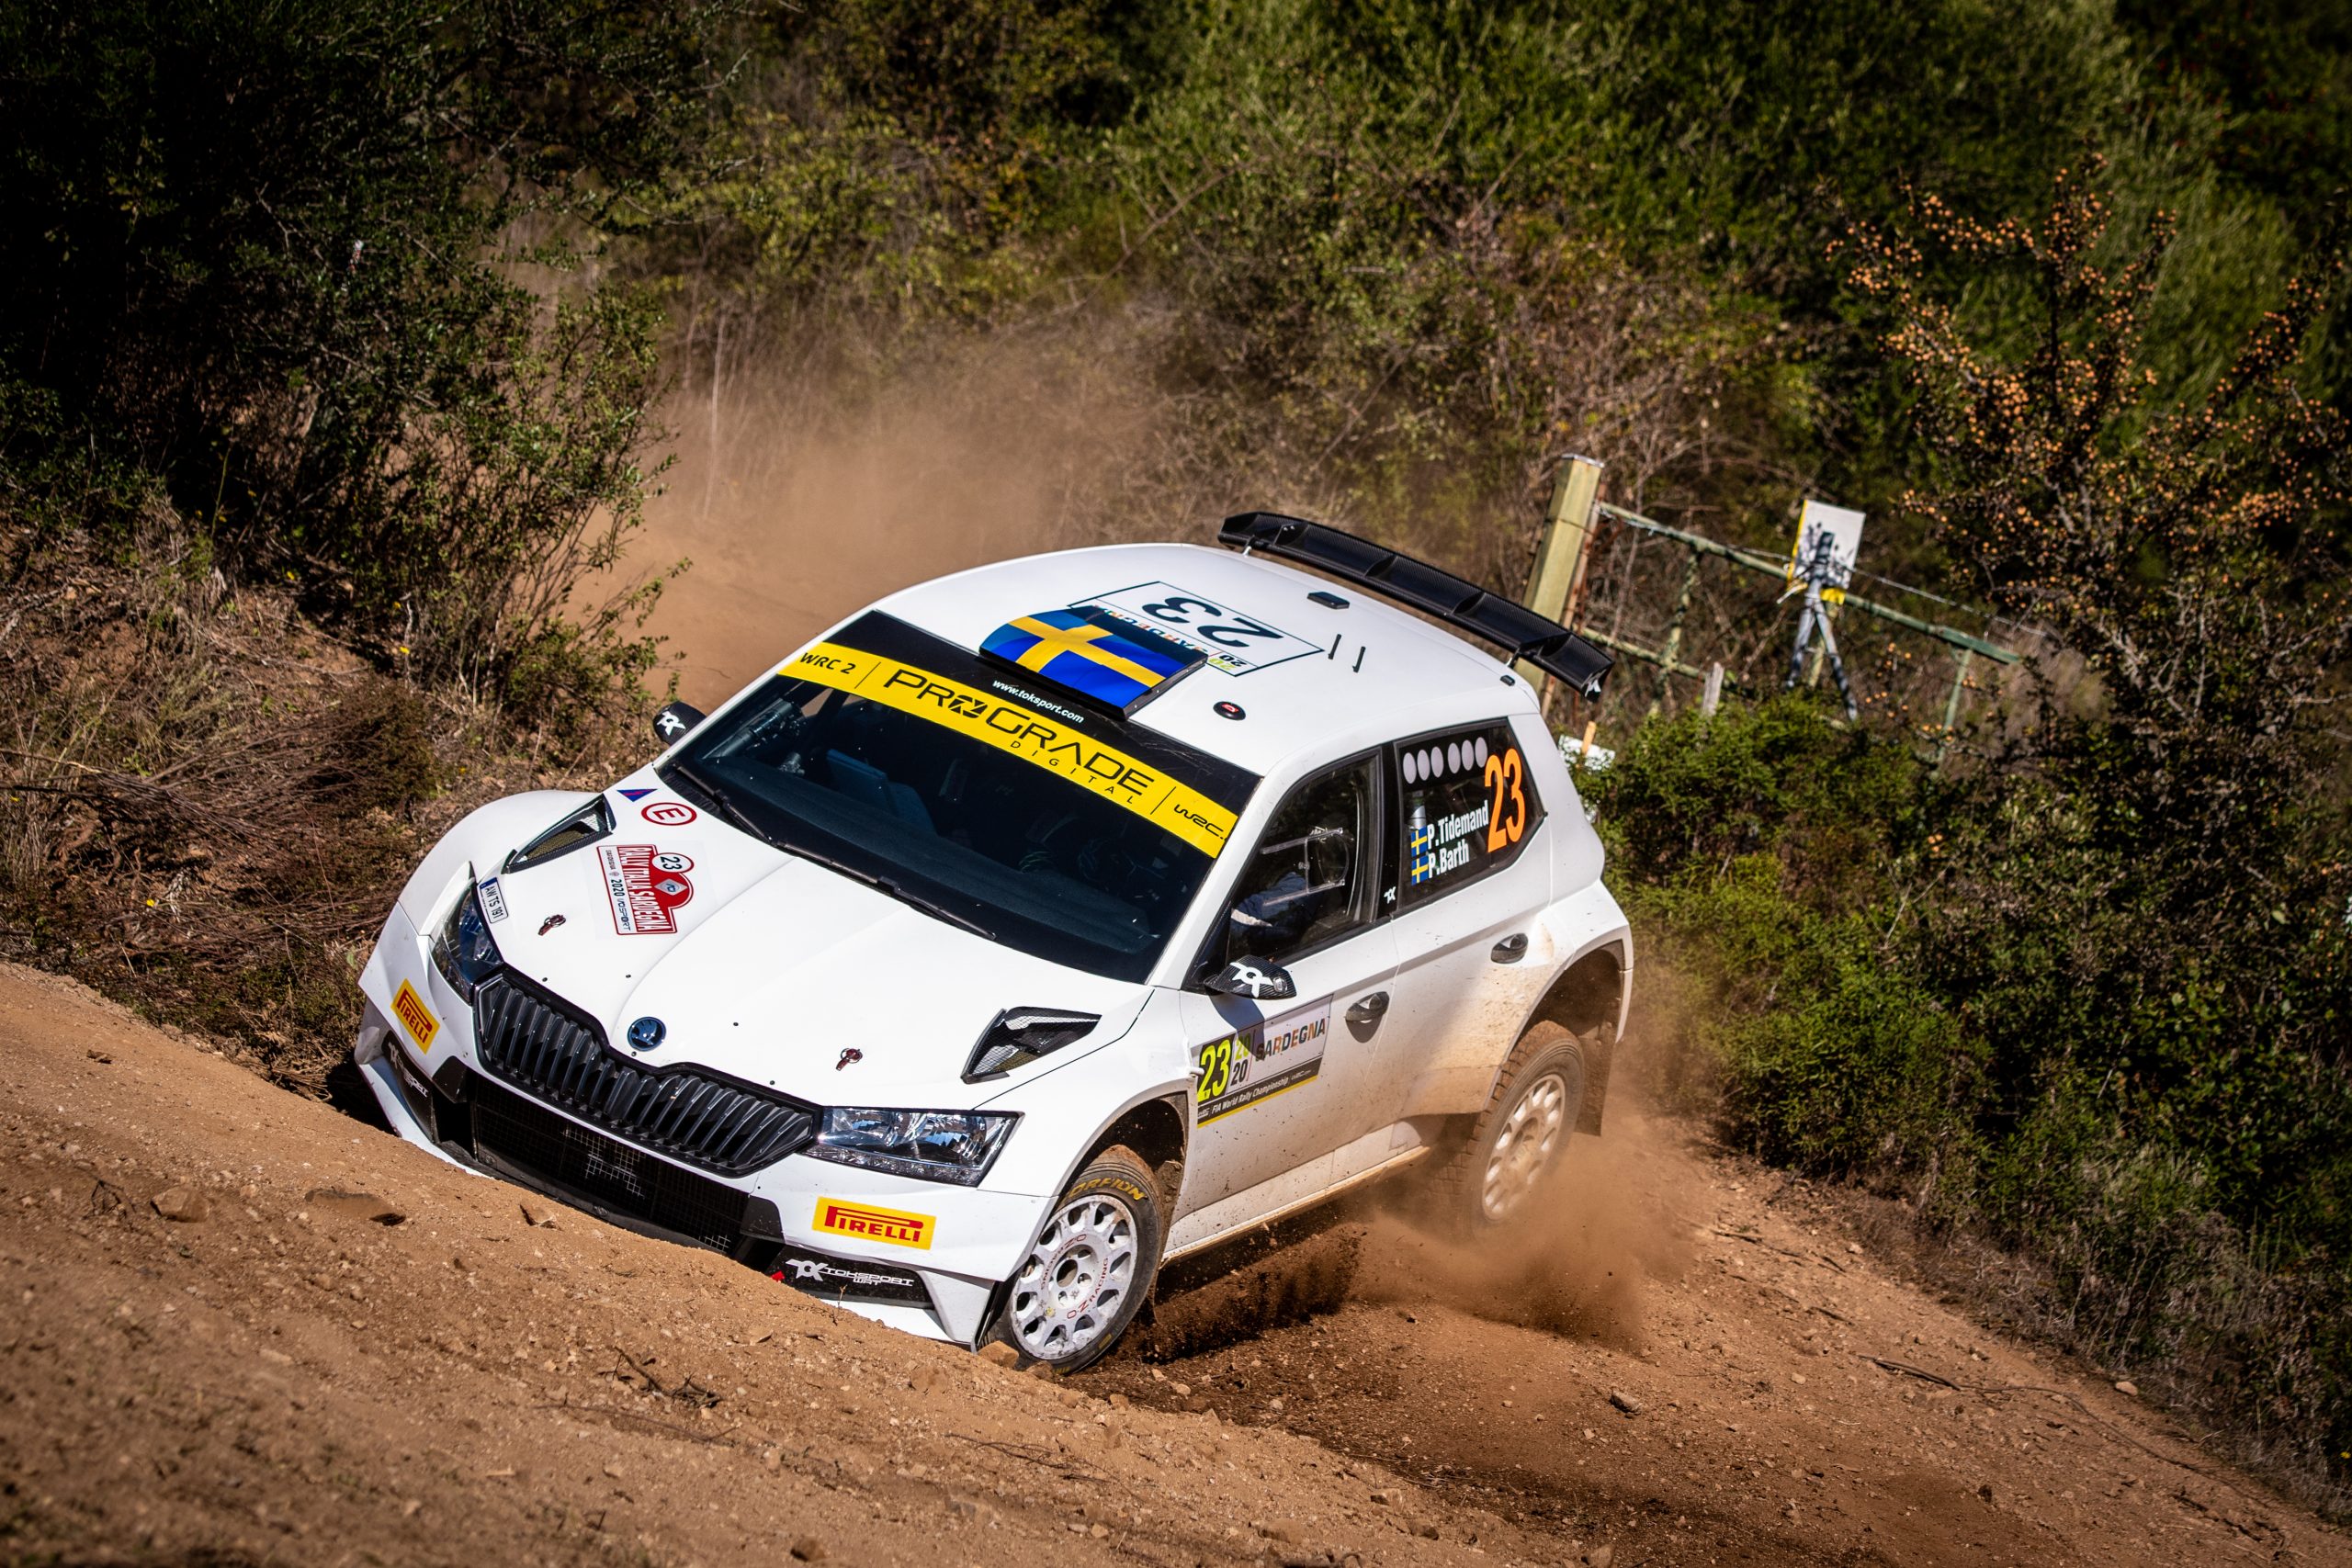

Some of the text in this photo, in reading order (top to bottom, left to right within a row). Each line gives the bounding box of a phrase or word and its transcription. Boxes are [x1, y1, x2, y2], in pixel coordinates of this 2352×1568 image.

[1141, 596, 1284, 648] 23
[798, 651, 855, 675] WRC 2
[991, 679, 1084, 724] www.toksport.com
[1010, 739, 1135, 805] DIGITAL
[651, 807, 686, 820] E
[1483, 747, 1525, 853] 23
[1427, 799, 1490, 851] P.Tidemand
[618, 847, 652, 867] RALLY
[660, 855, 683, 870] 23
[1428, 840, 1470, 879] P.Barth
[484, 885, 498, 897] AW
[610, 878, 626, 897] 2020
[622, 867, 652, 891] ITALIA
[488, 895, 501, 908] TS
[491, 906, 504, 919] 191
[628, 890, 673, 931] SARDEGNA
[395, 988, 433, 1044] PIRELLI
[1234, 1032, 1251, 1062] 20
[1255, 1017, 1327, 1063] SARDEGNA
[1197, 1038, 1233, 1103] 23
[1230, 1058, 1249, 1088] 20
[1211, 1105, 1223, 1114] FIA
[1222, 1096, 1238, 1110] World
[1238, 1090, 1253, 1103] Rally
[1252, 1076, 1289, 1098] Championship
[1064, 1177, 1148, 1201] ORPION
[824, 1205, 924, 1243] PIRELLI
